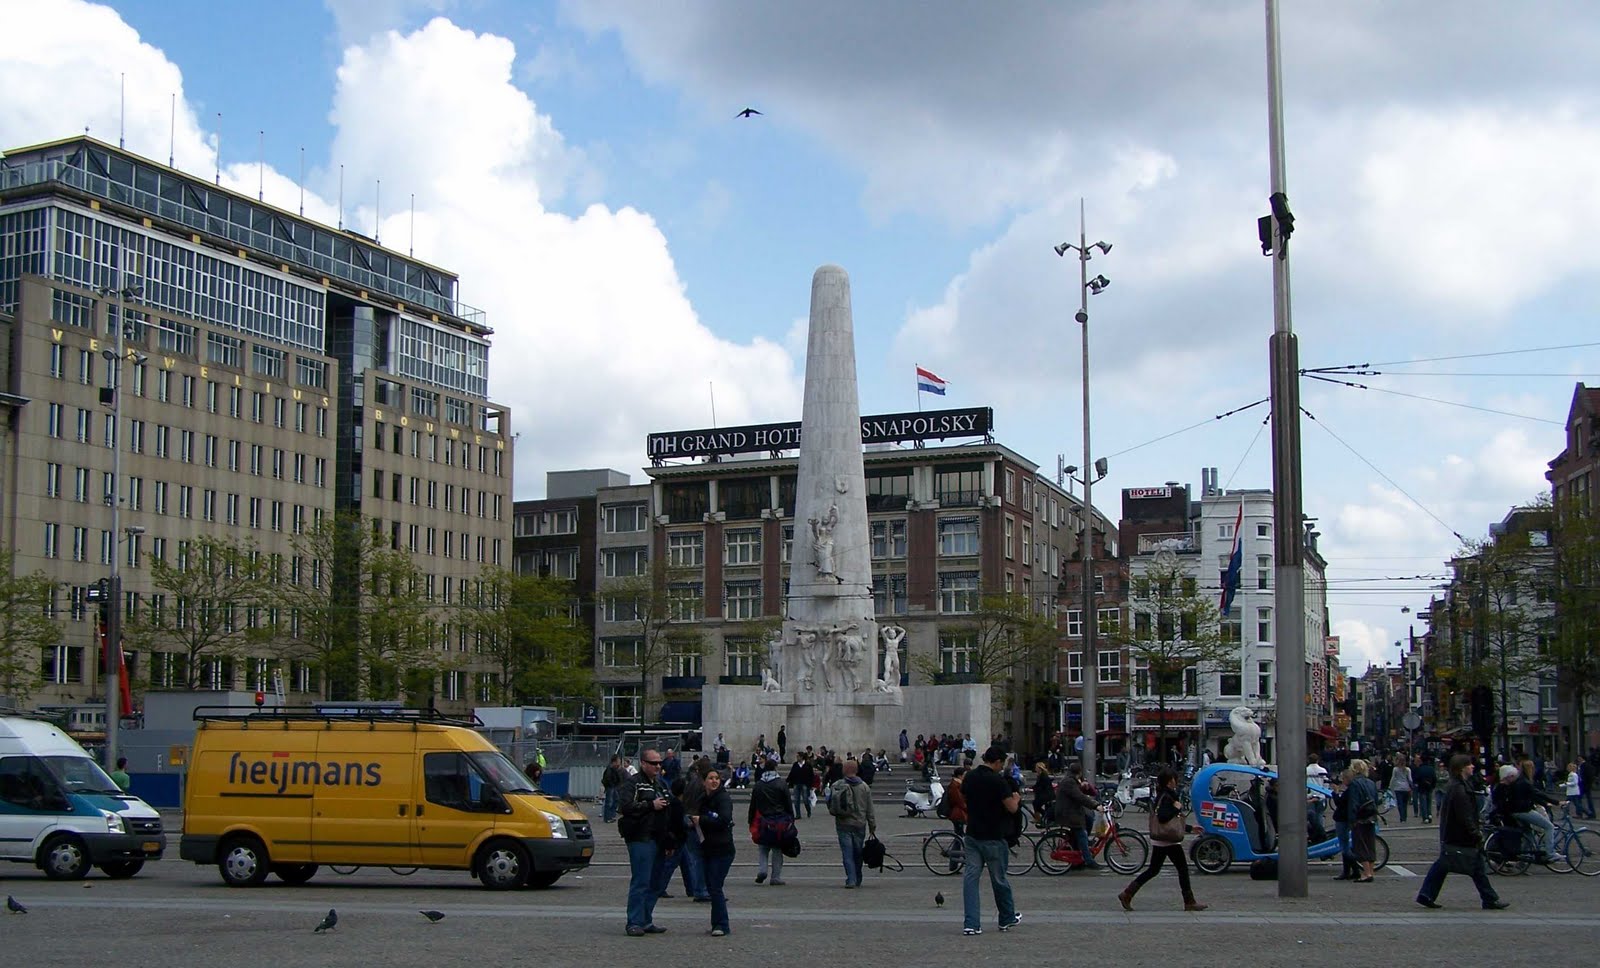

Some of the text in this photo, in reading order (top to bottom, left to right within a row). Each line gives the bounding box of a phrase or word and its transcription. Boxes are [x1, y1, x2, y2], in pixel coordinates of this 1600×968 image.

[52, 328, 504, 450] VERWELIUS BOUWEN
[681, 432, 747, 452] GRAND
[1312, 662, 1320, 704] HOTEL
[229, 751, 382, 794] heijmans
